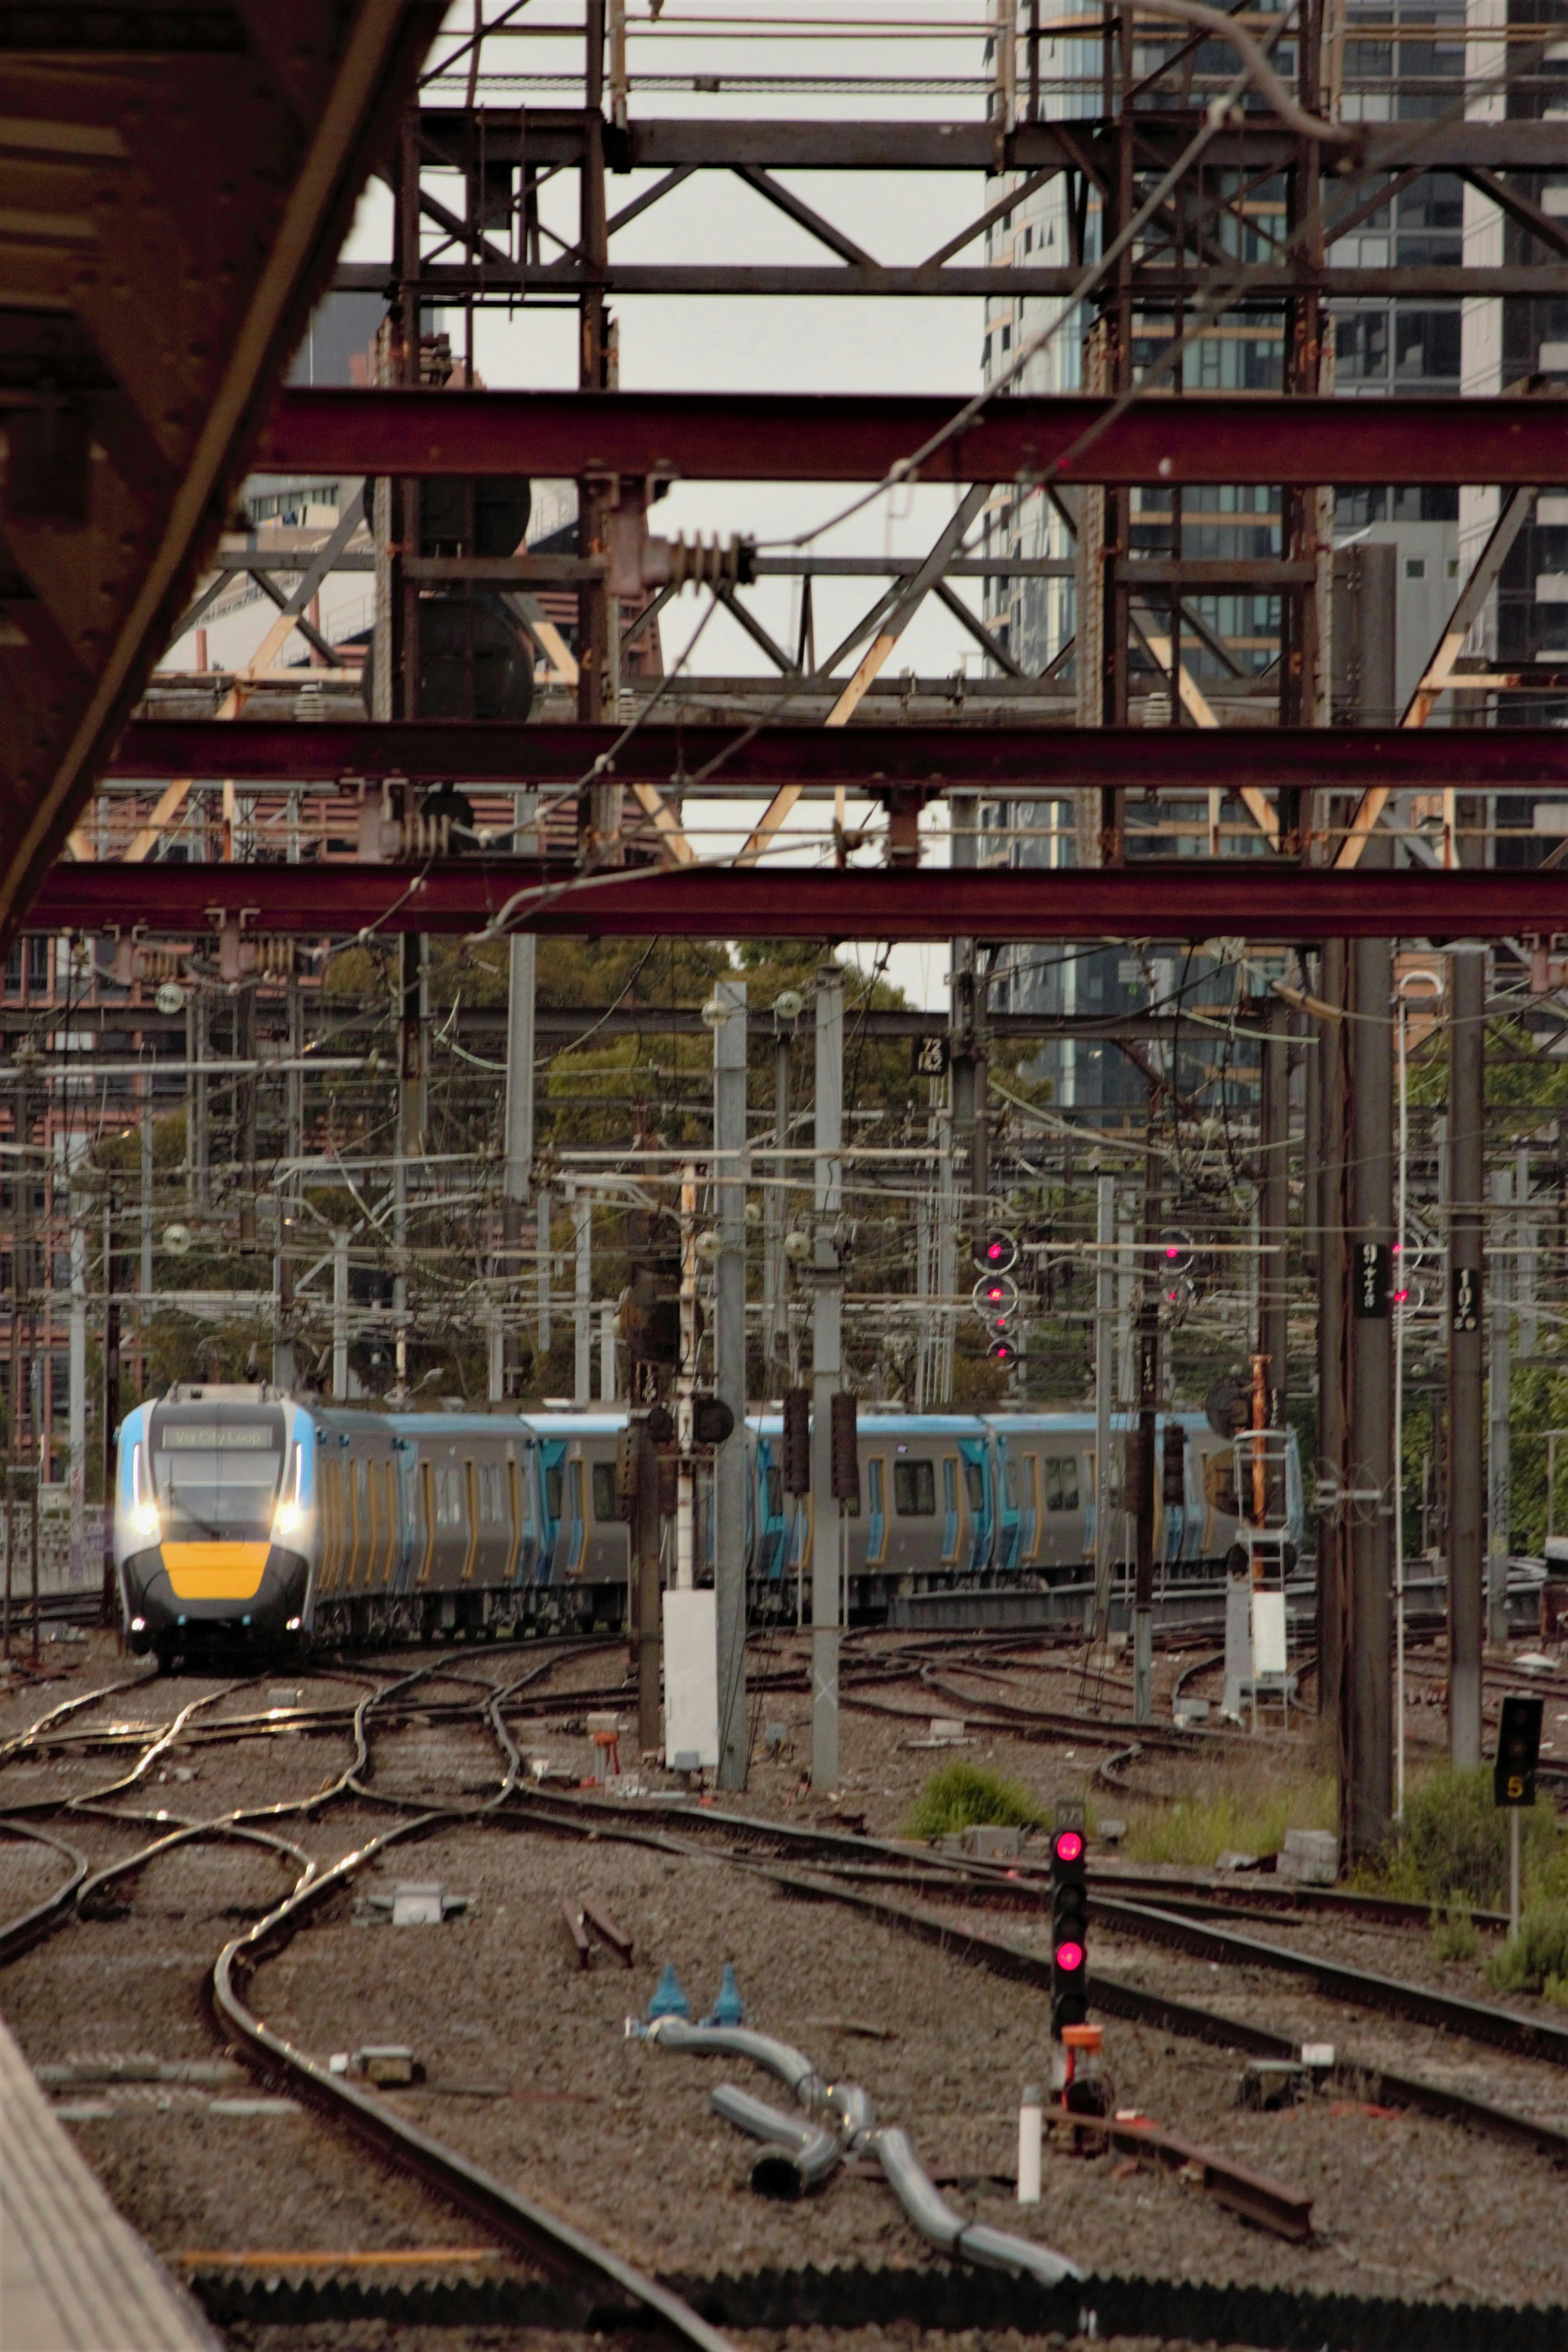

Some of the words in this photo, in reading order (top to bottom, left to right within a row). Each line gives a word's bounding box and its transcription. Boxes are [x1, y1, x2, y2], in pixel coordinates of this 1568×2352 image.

[923, 1037, 942, 1054] 72
[176, 1431, 195, 1445] Via
[199, 1431, 225, 1448] City
[228, 1431, 261, 1448] Loop
[1506, 1774, 1524, 1799] 5
